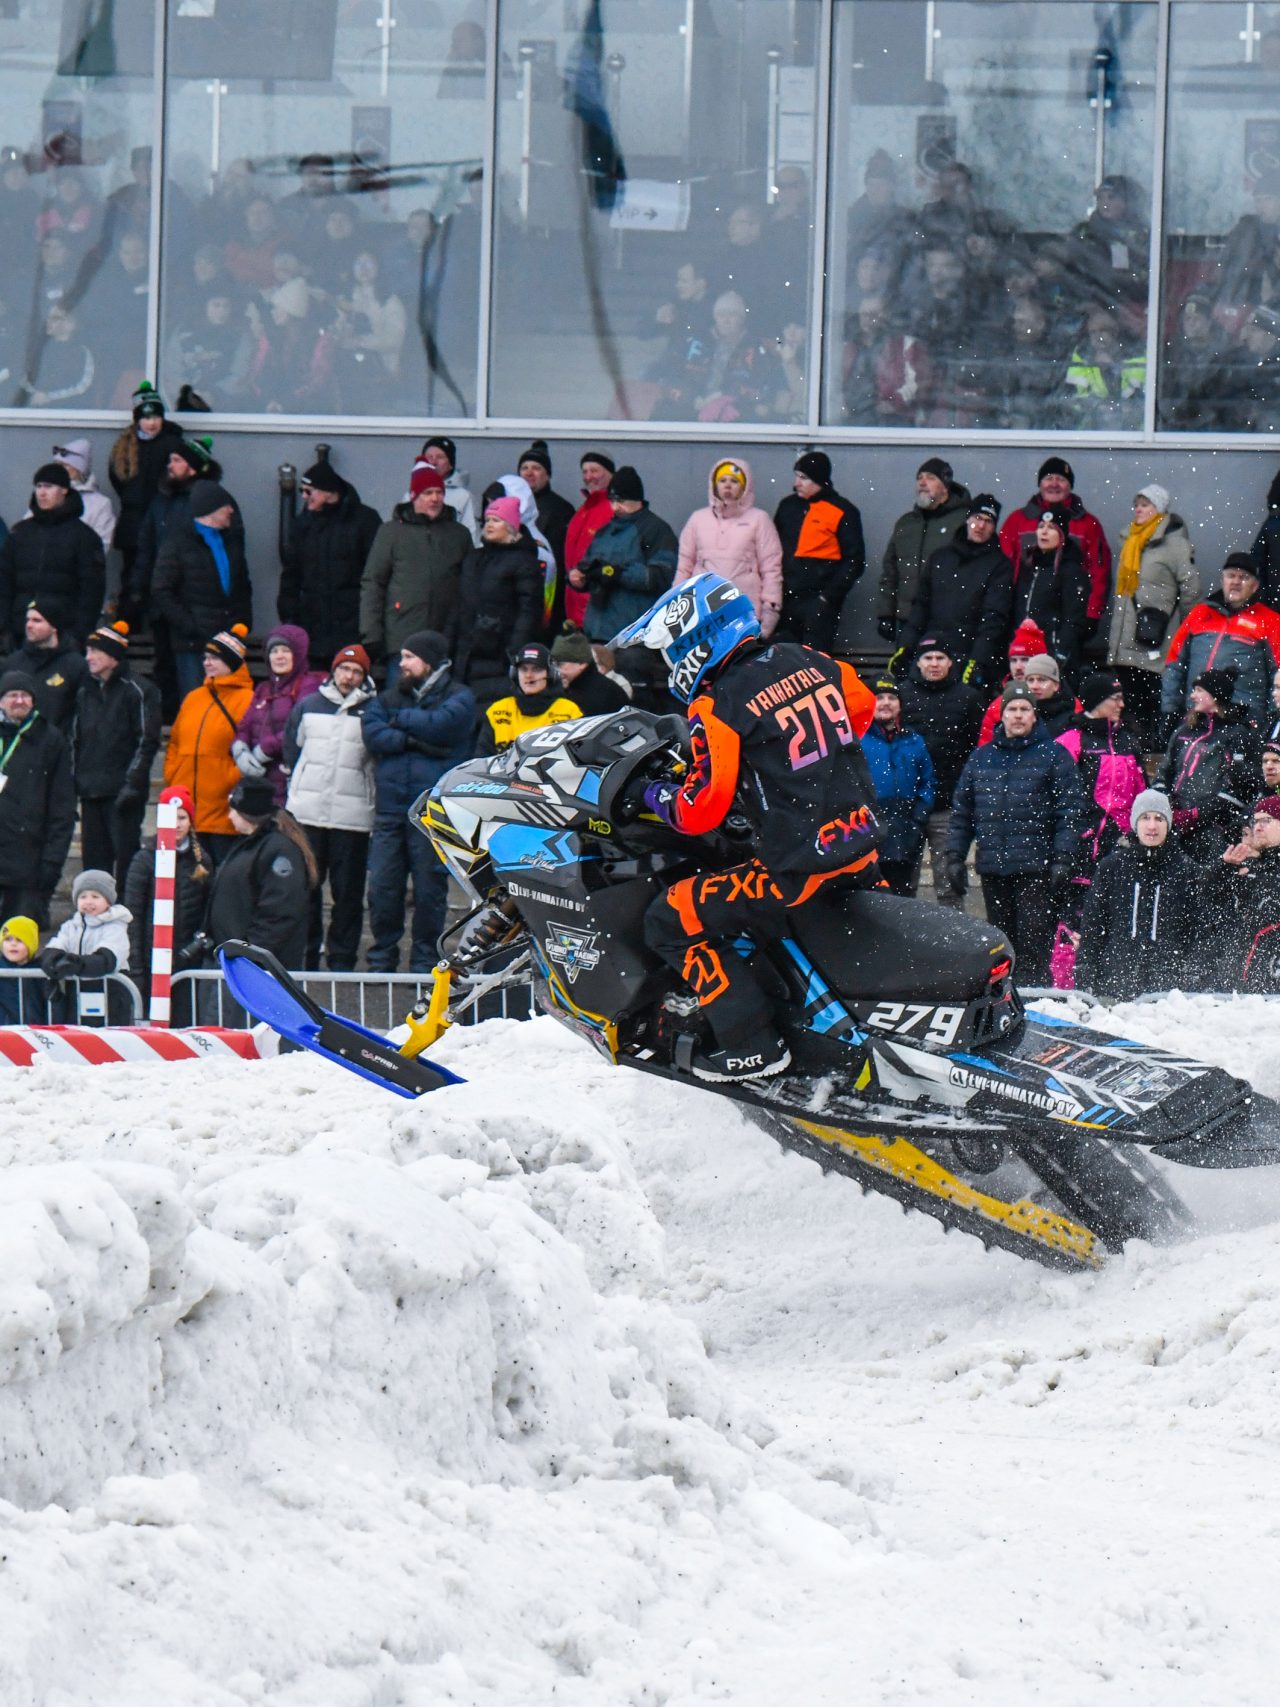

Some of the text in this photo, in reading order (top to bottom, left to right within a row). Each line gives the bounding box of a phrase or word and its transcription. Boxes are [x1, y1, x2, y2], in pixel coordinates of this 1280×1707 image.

[745, 667, 827, 718] VANHATALO
[774, 683, 853, 772] 279
[700, 870, 784, 904] FXR
[866, 1002, 966, 1046] 279
[726, 1053, 764, 1071] FXR
